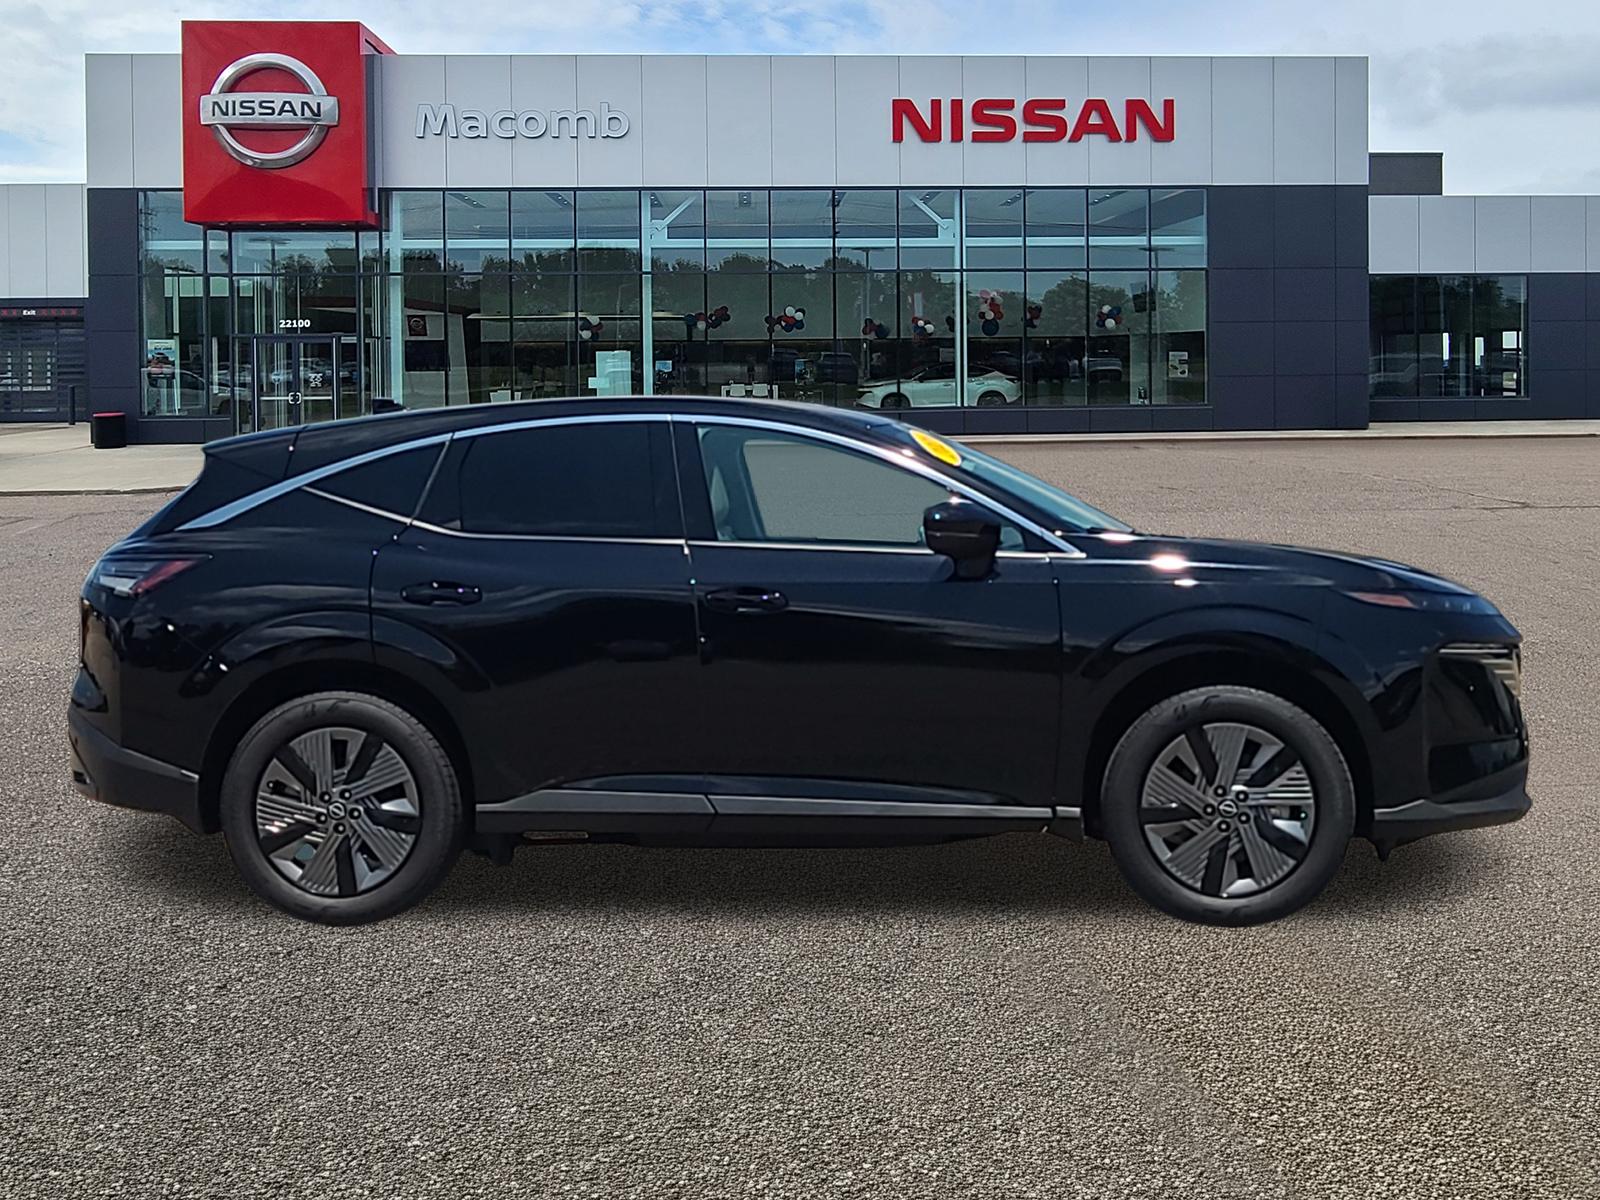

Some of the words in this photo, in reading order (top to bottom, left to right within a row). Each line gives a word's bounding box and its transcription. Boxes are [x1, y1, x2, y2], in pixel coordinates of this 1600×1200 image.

[212, 100, 321, 117] NISSAN
[415, 102, 630, 138] Macomb
[891, 98, 1175, 143] NISSAN
[279, 319, 311, 328] 22100
